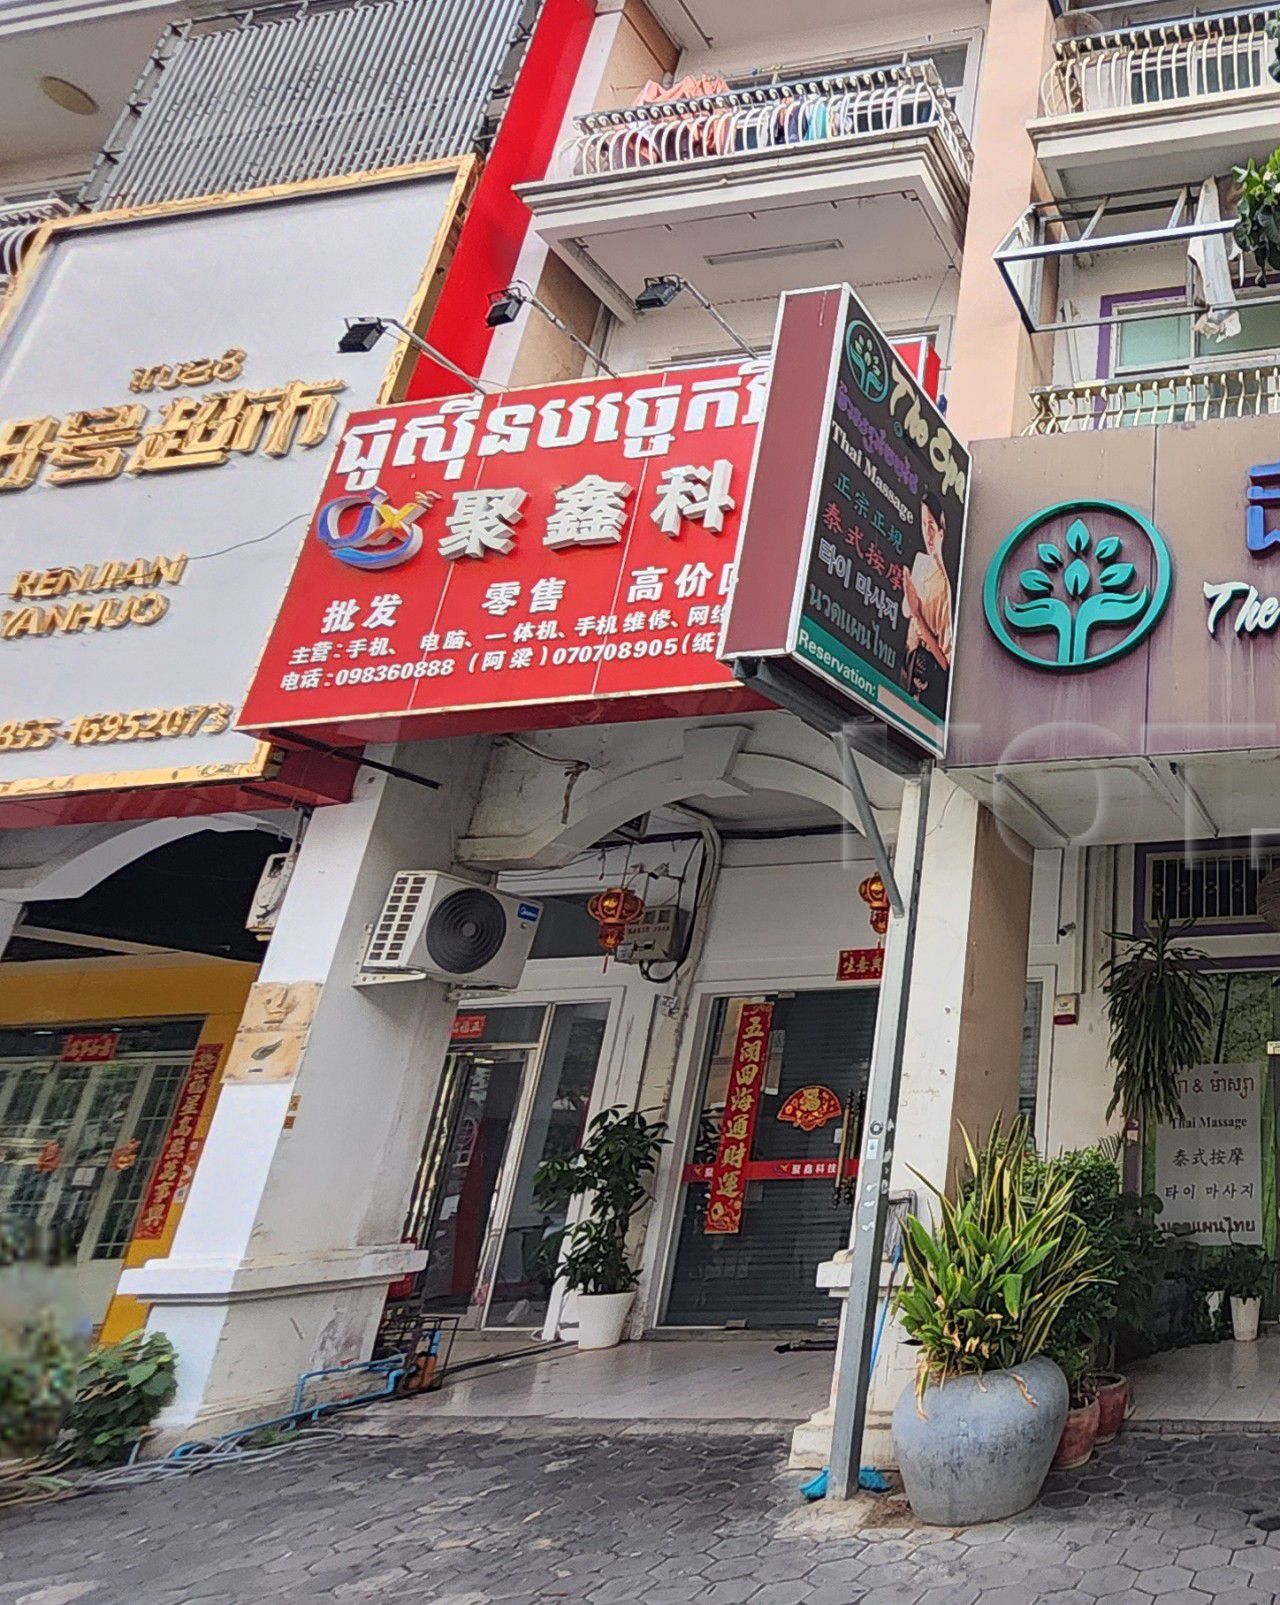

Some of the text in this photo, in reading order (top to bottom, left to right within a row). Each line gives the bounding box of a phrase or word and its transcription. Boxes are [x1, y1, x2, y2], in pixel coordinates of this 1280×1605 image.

[890, 358, 965, 504] The Spa
[832, 420, 914, 524] Thai Massage
[9, 553, 188, 600] RENJIAN
[818, 537, 900, 631] 타이 마사지
[320, 593, 403, 634] 批发
[481, 577, 567, 616] 零售
[1203, 581, 1280, 636] The
[798, 628, 876, 697] Reservation:
[1199, 1116, 1248, 1131] Massage
[1172, 1147, 1245, 1168] 泰式按摩
[1165, 1182, 1254, 1200] 타이 마사지
